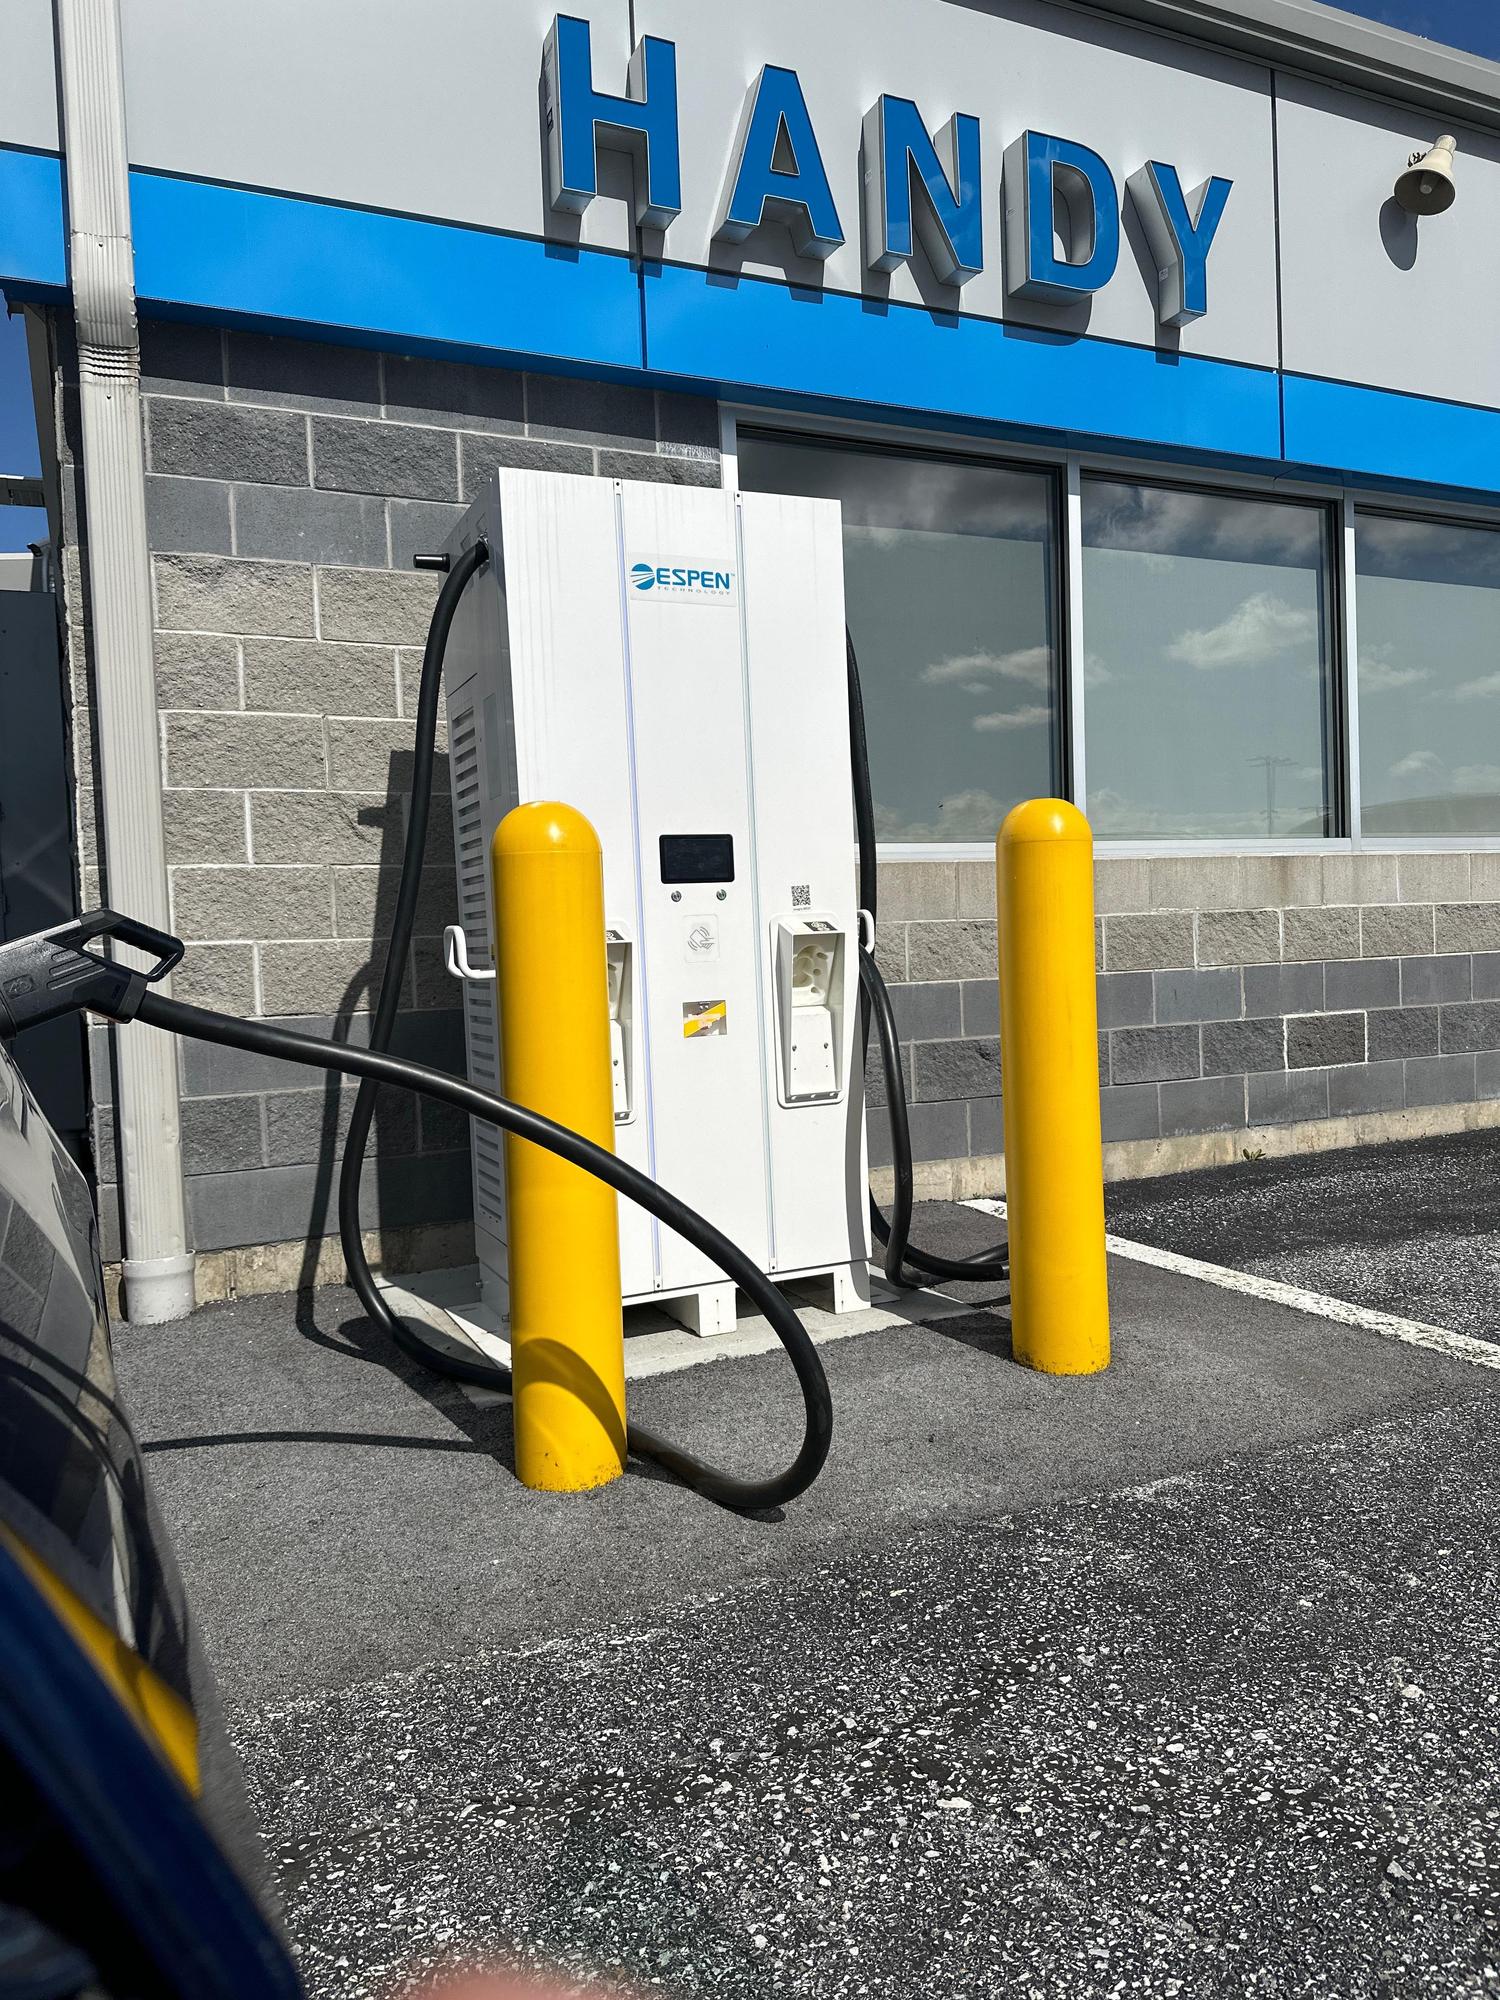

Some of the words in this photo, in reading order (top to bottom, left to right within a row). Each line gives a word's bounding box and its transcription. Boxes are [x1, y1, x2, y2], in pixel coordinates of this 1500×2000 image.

[550, 13, 1234, 322] HANDY
[656, 567, 730, 590] ESPEN
[657, 586, 730, 595] TECHNOLOGY
